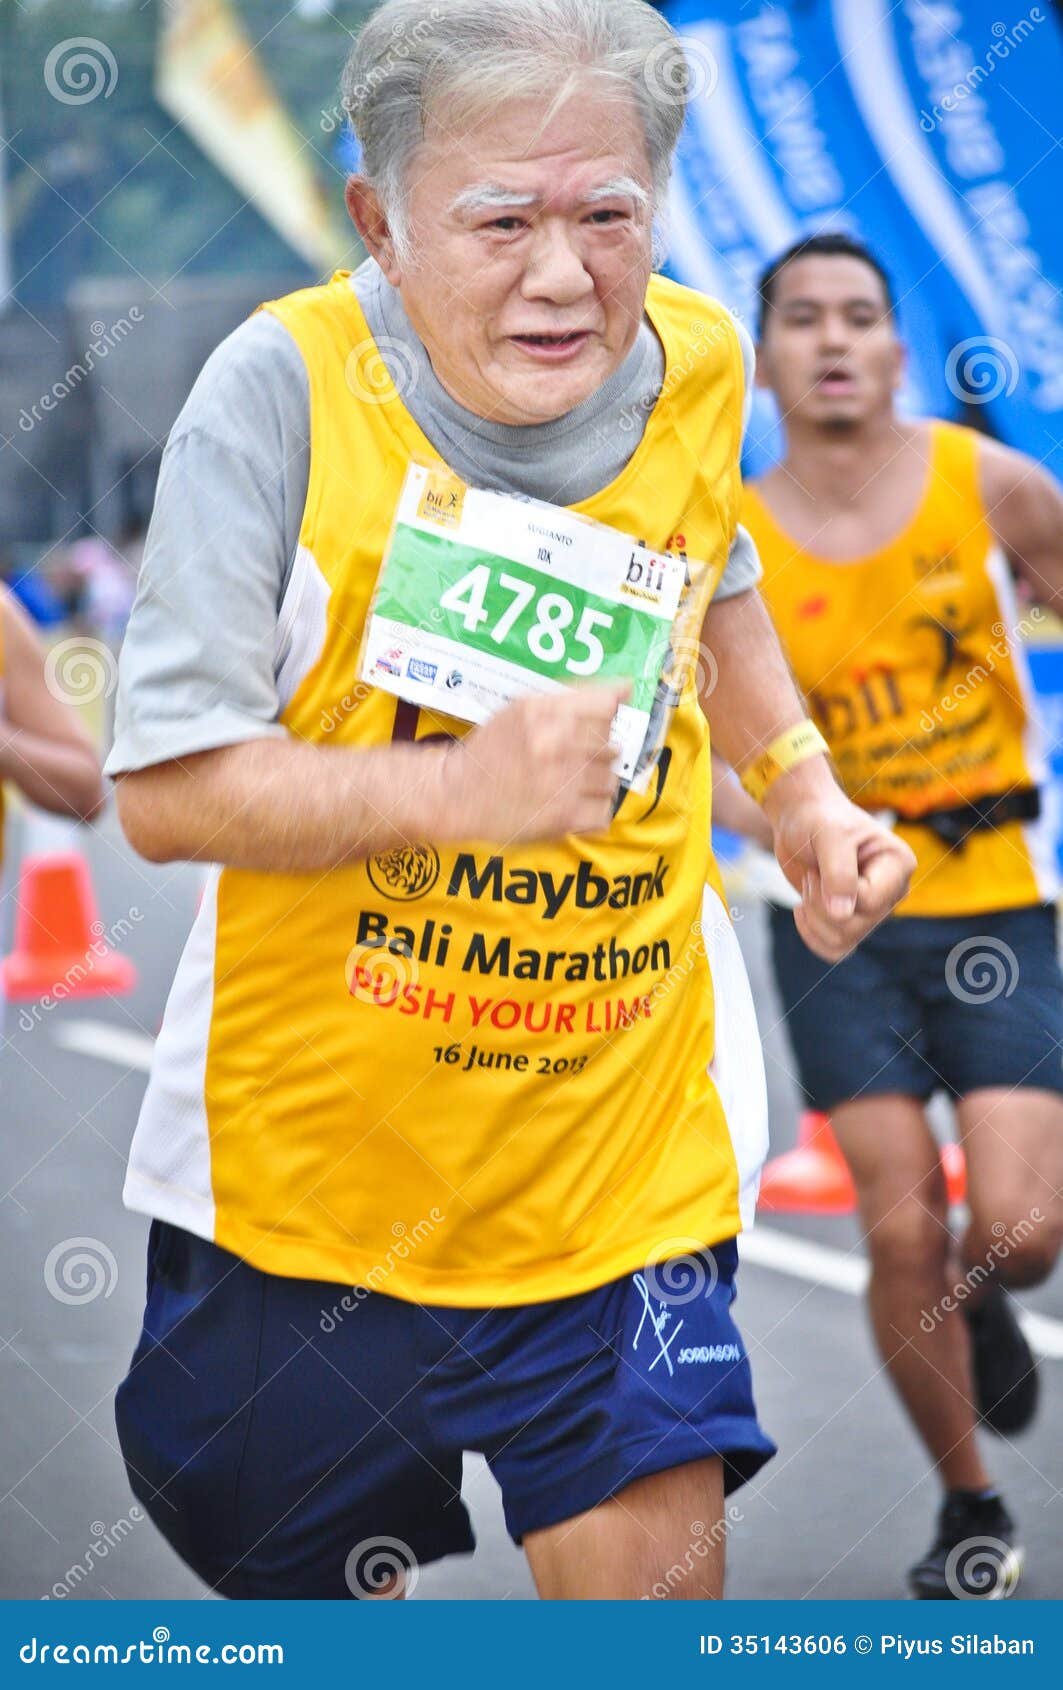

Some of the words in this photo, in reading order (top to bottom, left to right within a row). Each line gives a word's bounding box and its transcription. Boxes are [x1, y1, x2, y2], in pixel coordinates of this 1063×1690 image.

[626, 552, 666, 590] bii
[440, 564, 614, 676] 4785
[446, 852, 668, 920] Maybank
[355, 910, 453, 968] Bali
[461, 931, 671, 982] Marathon
[349, 965, 456, 1025] PUSH
[468, 995, 577, 1034] YOUR
[433, 1043, 462, 1065] 16
[462, 1045, 529, 1072] June
